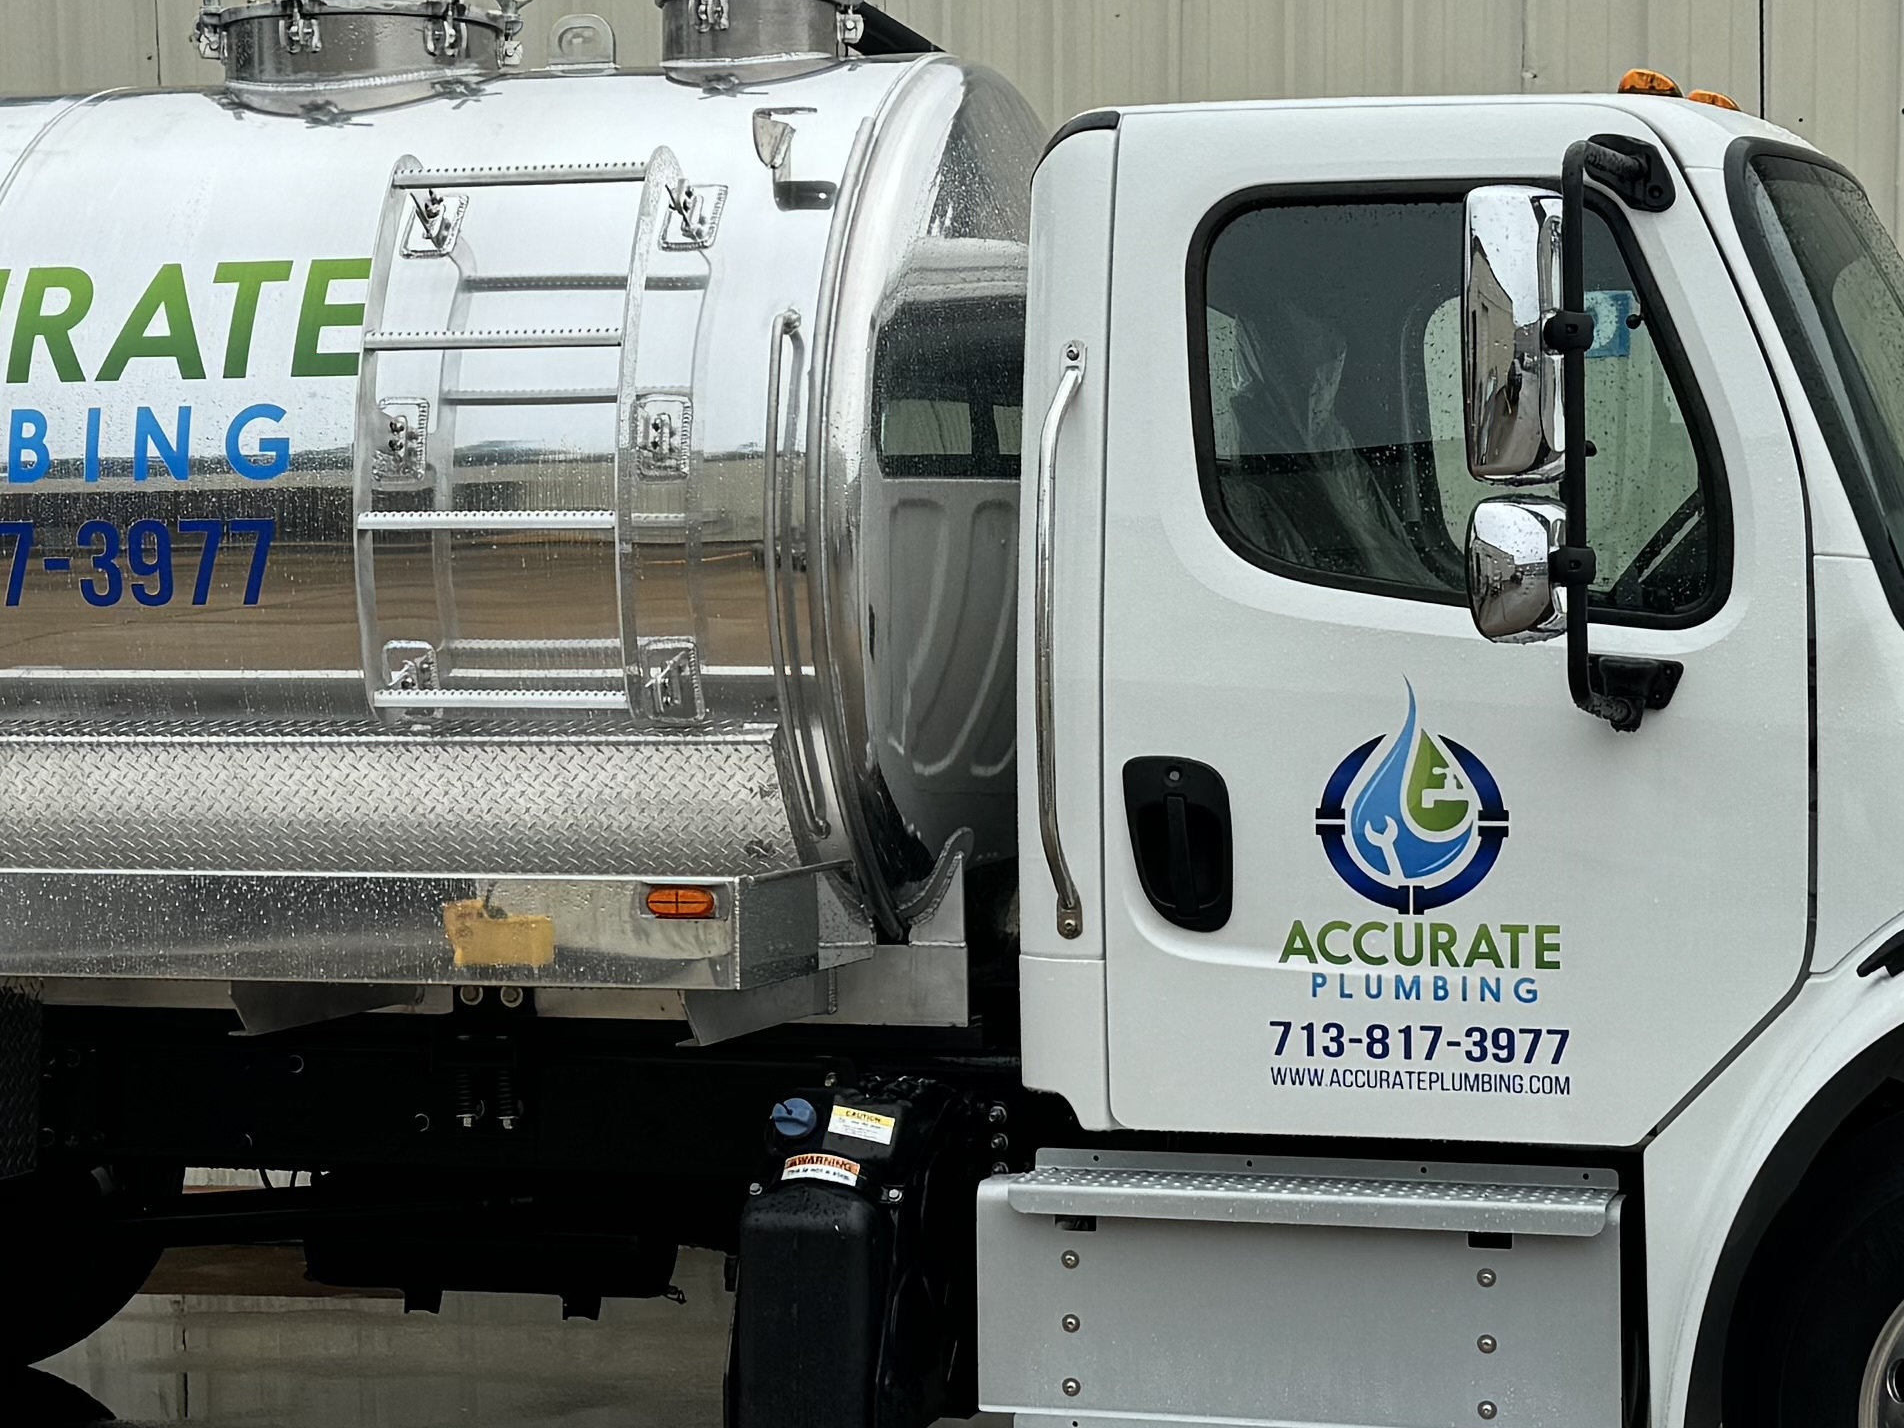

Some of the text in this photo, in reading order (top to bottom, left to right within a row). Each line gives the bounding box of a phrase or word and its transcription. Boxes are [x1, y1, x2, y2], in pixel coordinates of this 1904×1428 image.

[1278, 919, 1561, 970] ACCURATE
[1311, 972, 1538, 1004] PLUMBING
[1269, 1020, 1570, 1065] 713-817-3977
[1270, 1066, 1571, 1096] WWW.ACCURATEPLUMBING.COM
[845, 1110, 881, 1123] CAUTION
[797, 1155, 851, 1171] WARNING
